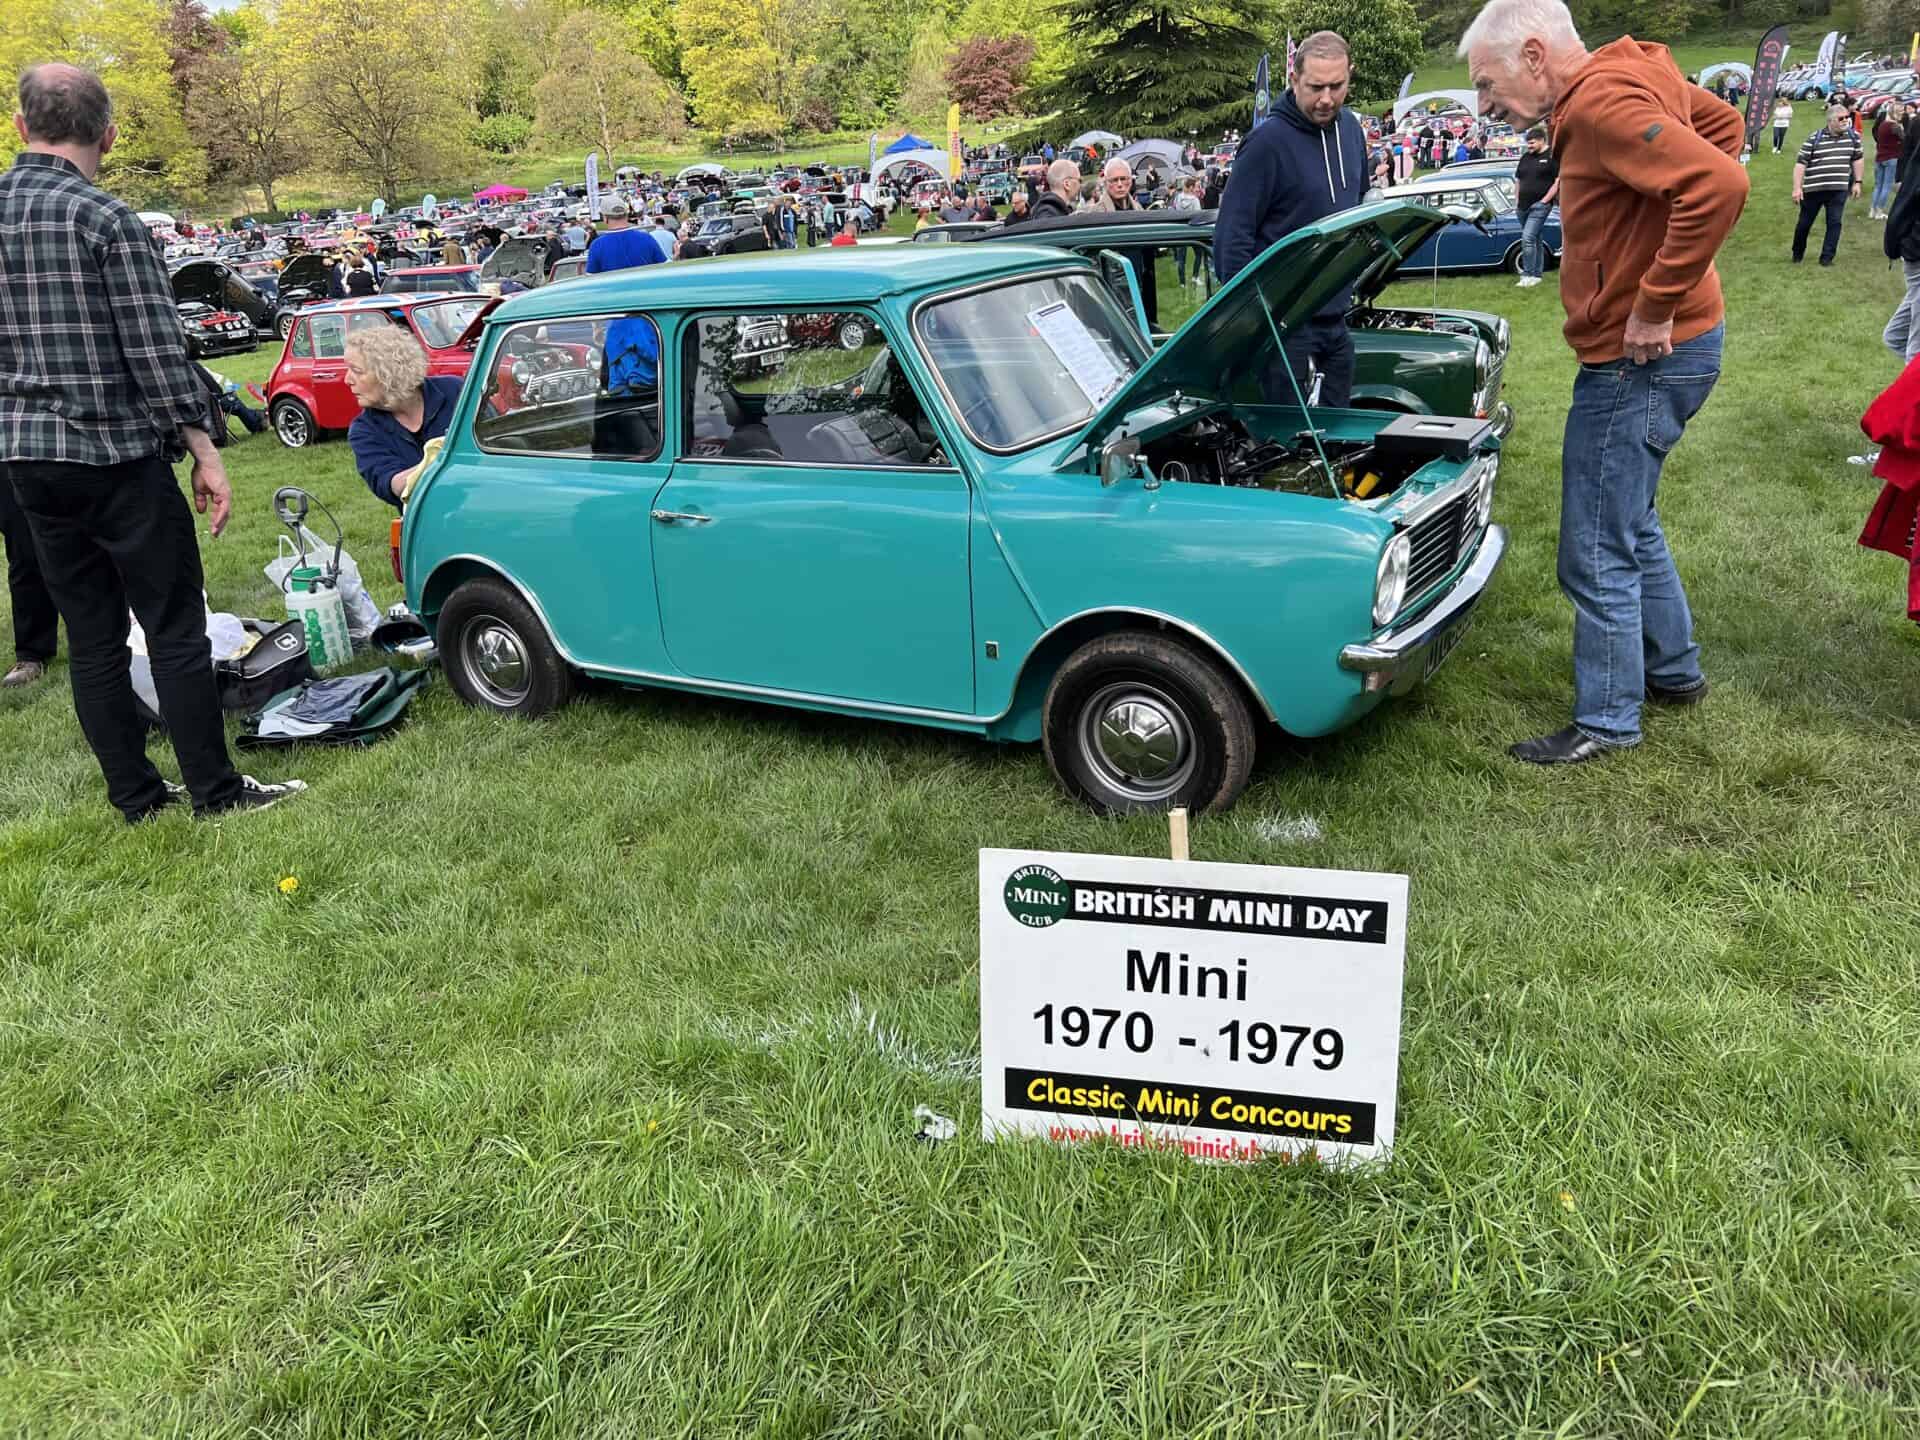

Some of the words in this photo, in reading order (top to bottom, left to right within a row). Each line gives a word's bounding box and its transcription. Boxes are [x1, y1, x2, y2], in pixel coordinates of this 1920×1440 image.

[1013, 866, 1061, 885] BRITISH
[1013, 886, 1060, 906] MINI
[1019, 913, 1053, 926] CLUB
[1074, 888, 1195, 920] BRITISH
[1208, 898, 1292, 928] MINI
[1305, 905, 1373, 933] DAY
[1126, 949, 1247, 1001] Mini
[1033, 1003, 1154, 1053] 1970
[1178, 1037, 1197, 1047] -
[1218, 1019, 1344, 1071] 1979
[1027, 1077, 1126, 1110] Classic
[1136, 1087, 1200, 1117] Mini
[1210, 1096, 1353, 1134] Concours
